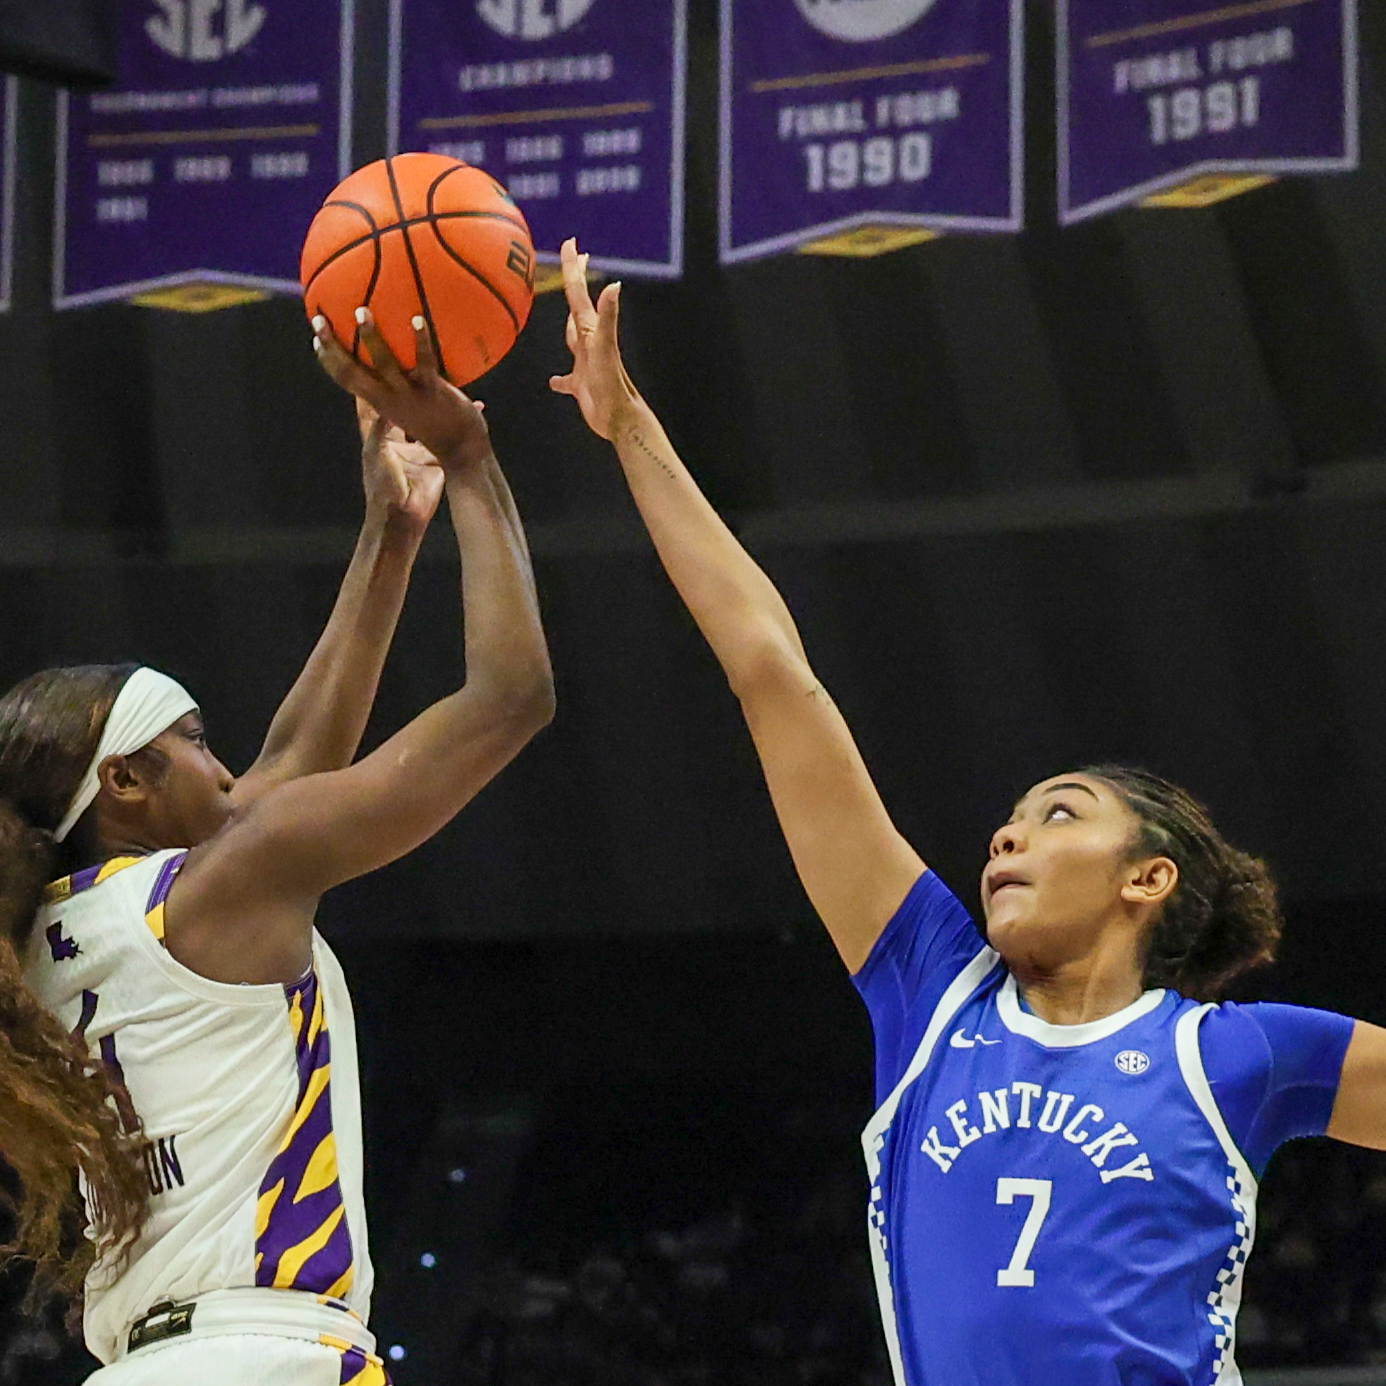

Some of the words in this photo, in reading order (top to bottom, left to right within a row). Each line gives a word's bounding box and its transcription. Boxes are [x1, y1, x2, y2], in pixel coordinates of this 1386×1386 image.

[778, 101, 866, 141] FINAL
[1148, 75, 1260, 145] 1991
[805, 132, 932, 192] 1990
[1117, 1051, 1148, 1073] SEC
[921, 1081, 1155, 1184] KENTUCKY
[996, 1177, 1053, 1287] 7
